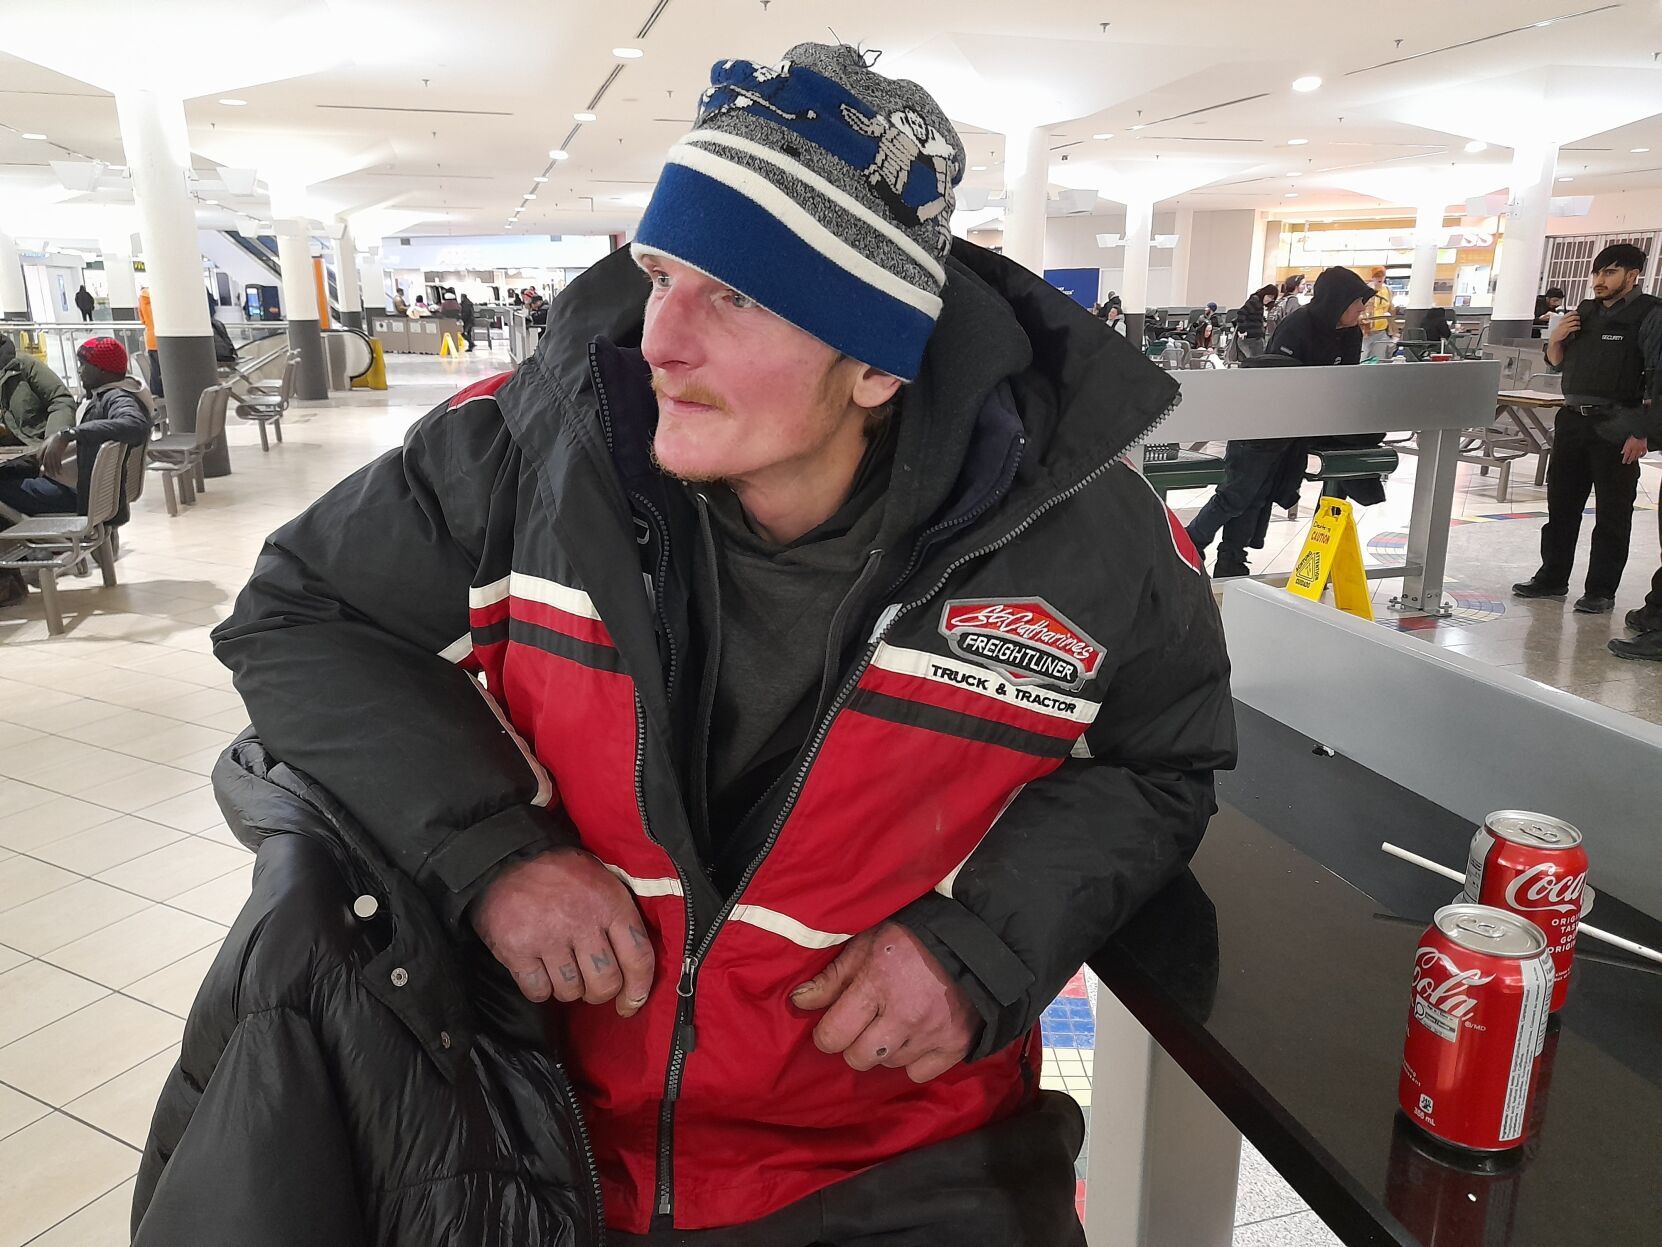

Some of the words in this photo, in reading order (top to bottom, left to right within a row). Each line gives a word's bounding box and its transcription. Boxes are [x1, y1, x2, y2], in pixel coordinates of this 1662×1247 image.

[1311, 531, 1330, 544] CAUTION
[963, 635, 1074, 680] FREIGHTLINER
[1002, 612, 1094, 660] Catharines
[931, 663, 990, 691] TRUCK
[995, 682, 1007, 696] &
[1015, 687, 1077, 714] TRACTOR
[1505, 862, 1587, 914] Coca
